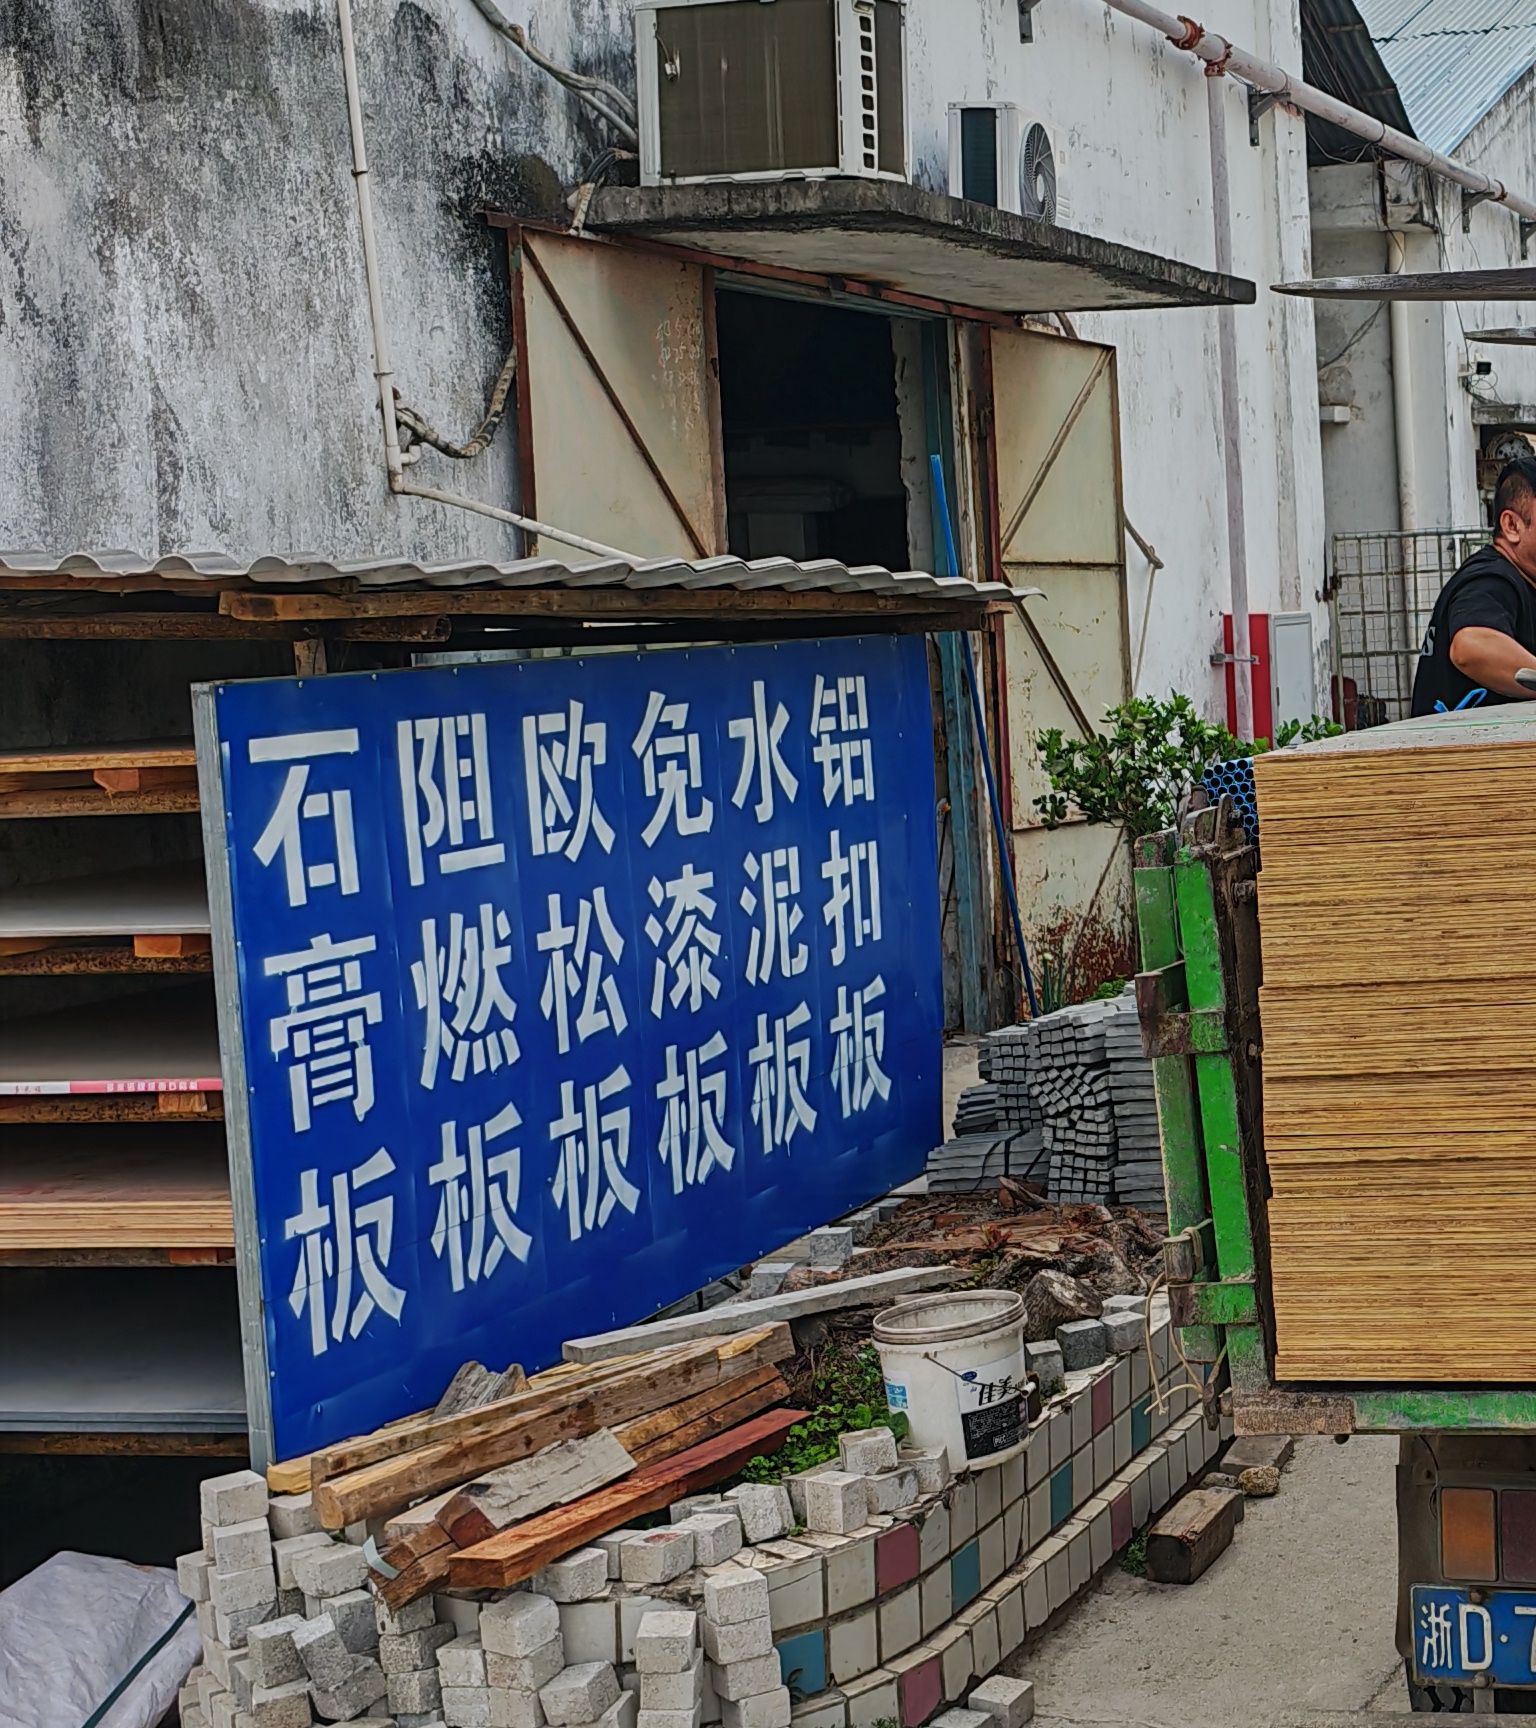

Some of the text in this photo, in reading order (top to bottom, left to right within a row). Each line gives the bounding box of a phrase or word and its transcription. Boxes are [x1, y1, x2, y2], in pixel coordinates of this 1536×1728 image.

[249, 729, 406, 1356] 石膏板
[397, 713, 533, 1292] 阻燃板
[522, 699, 641, 1241] 欧松板
[632, 691, 735, 1195] 免漆板
[728, 680, 817, 1155] 水泥板
[810, 674, 891, 1118] 铝扣板
